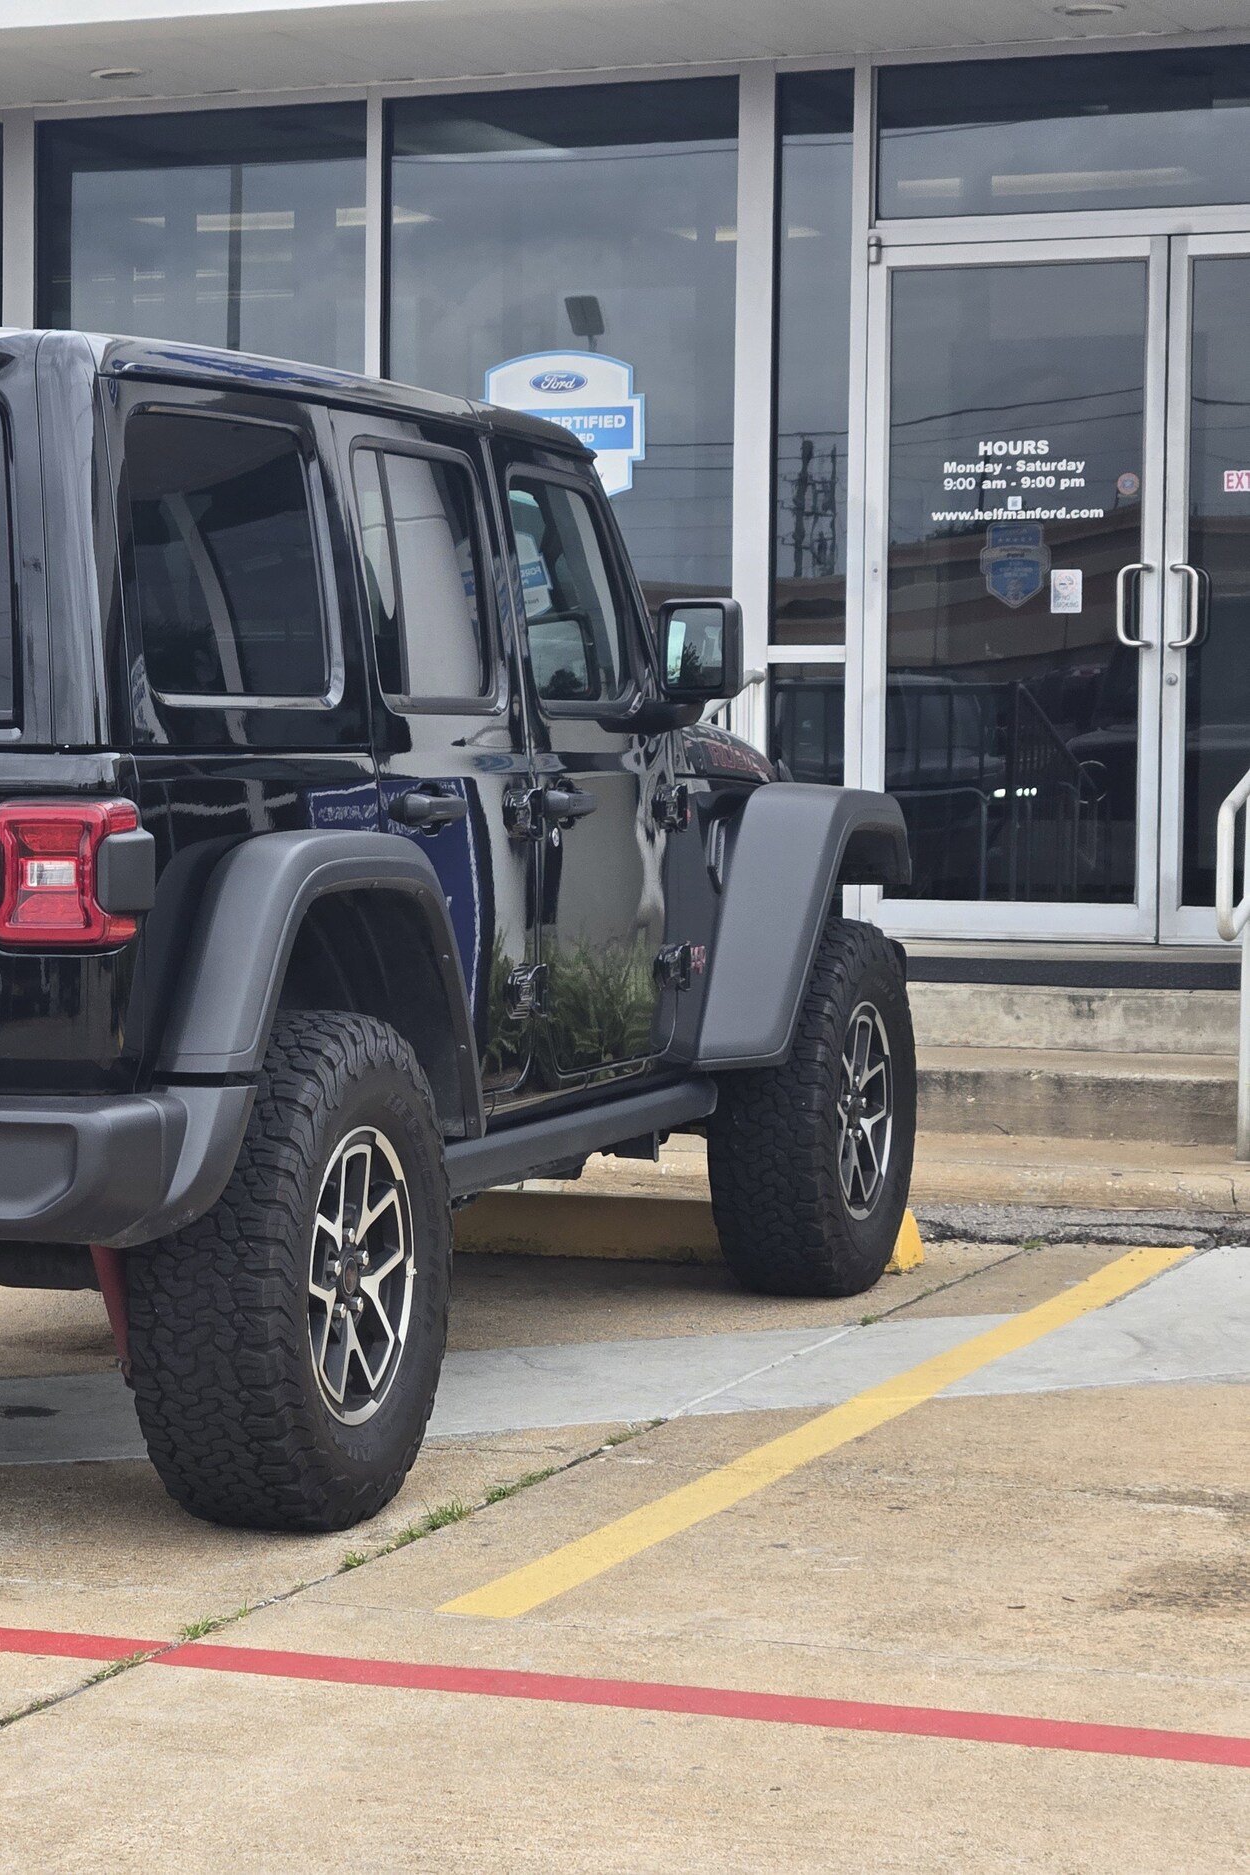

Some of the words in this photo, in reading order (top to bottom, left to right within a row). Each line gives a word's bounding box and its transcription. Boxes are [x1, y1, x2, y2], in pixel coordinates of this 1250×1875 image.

[541, 374, 577, 390] Ford
[542, 414, 626, 429] ERTIFIED
[978, 439, 1050, 456] HOURS
[943, 461, 1003, 475] Monday
[1015, 459, 1086, 473] Saturday
[943, 477, 976, 491] 9:00
[981, 478, 1007, 489] am
[1020, 476, 1056, 488] 9:00
[1060, 476, 1086, 490] pm
[931, 507, 1104, 521] www.helfmanford.com
